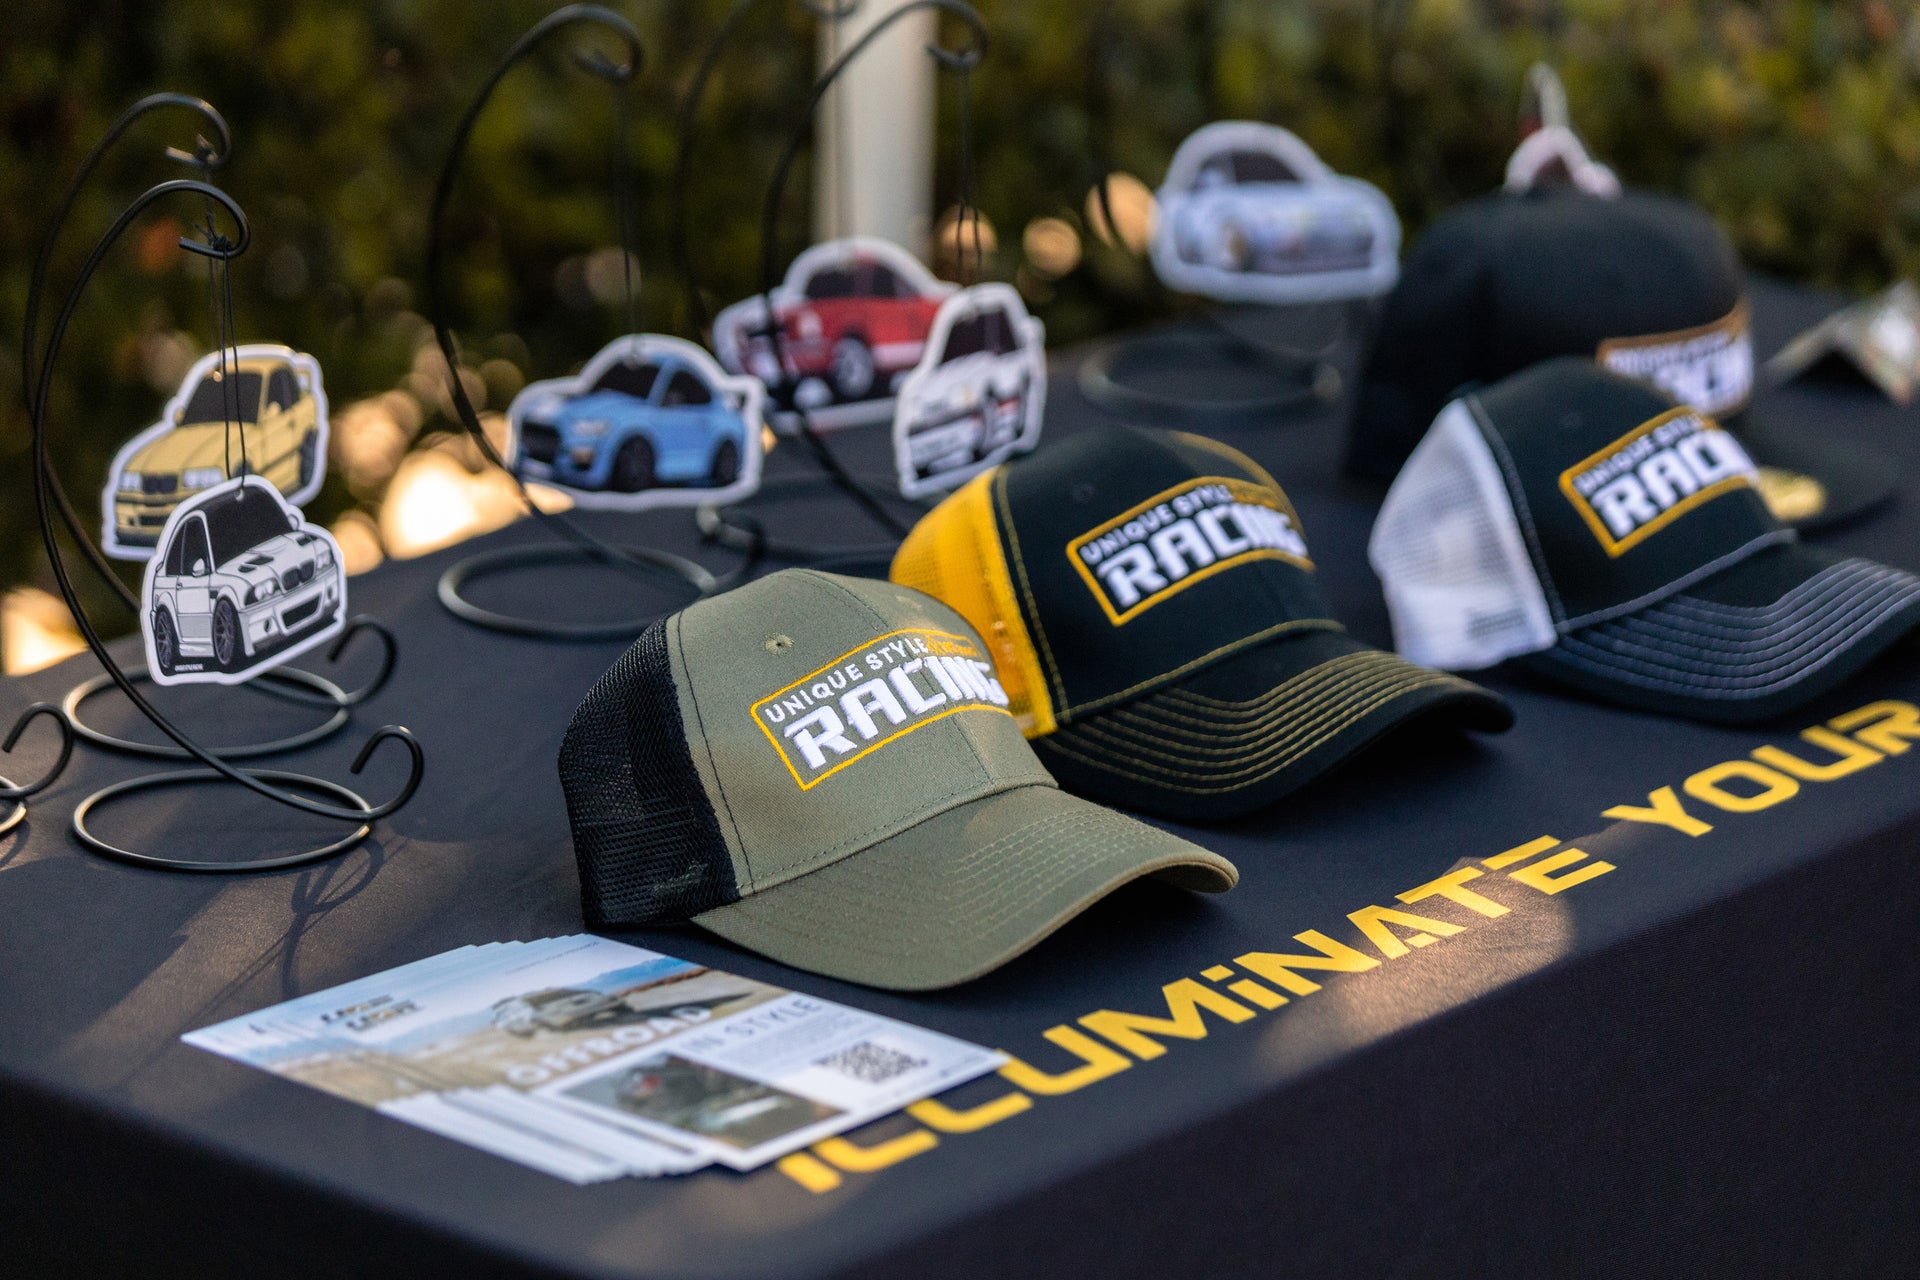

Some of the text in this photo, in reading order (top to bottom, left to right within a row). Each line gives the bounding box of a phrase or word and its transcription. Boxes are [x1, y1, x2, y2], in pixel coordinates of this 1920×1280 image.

[1079, 503, 1177, 565] UNIQUE
[765, 663, 864, 723] UNIQUE
[864, 637, 929, 672] STYLE
[783, 655, 1010, 770] RACING
[1600, 698, 1920, 838] YOUR
[504, 1004, 713, 1084] OFFROAD
[723, 997, 824, 1037] STYLE
